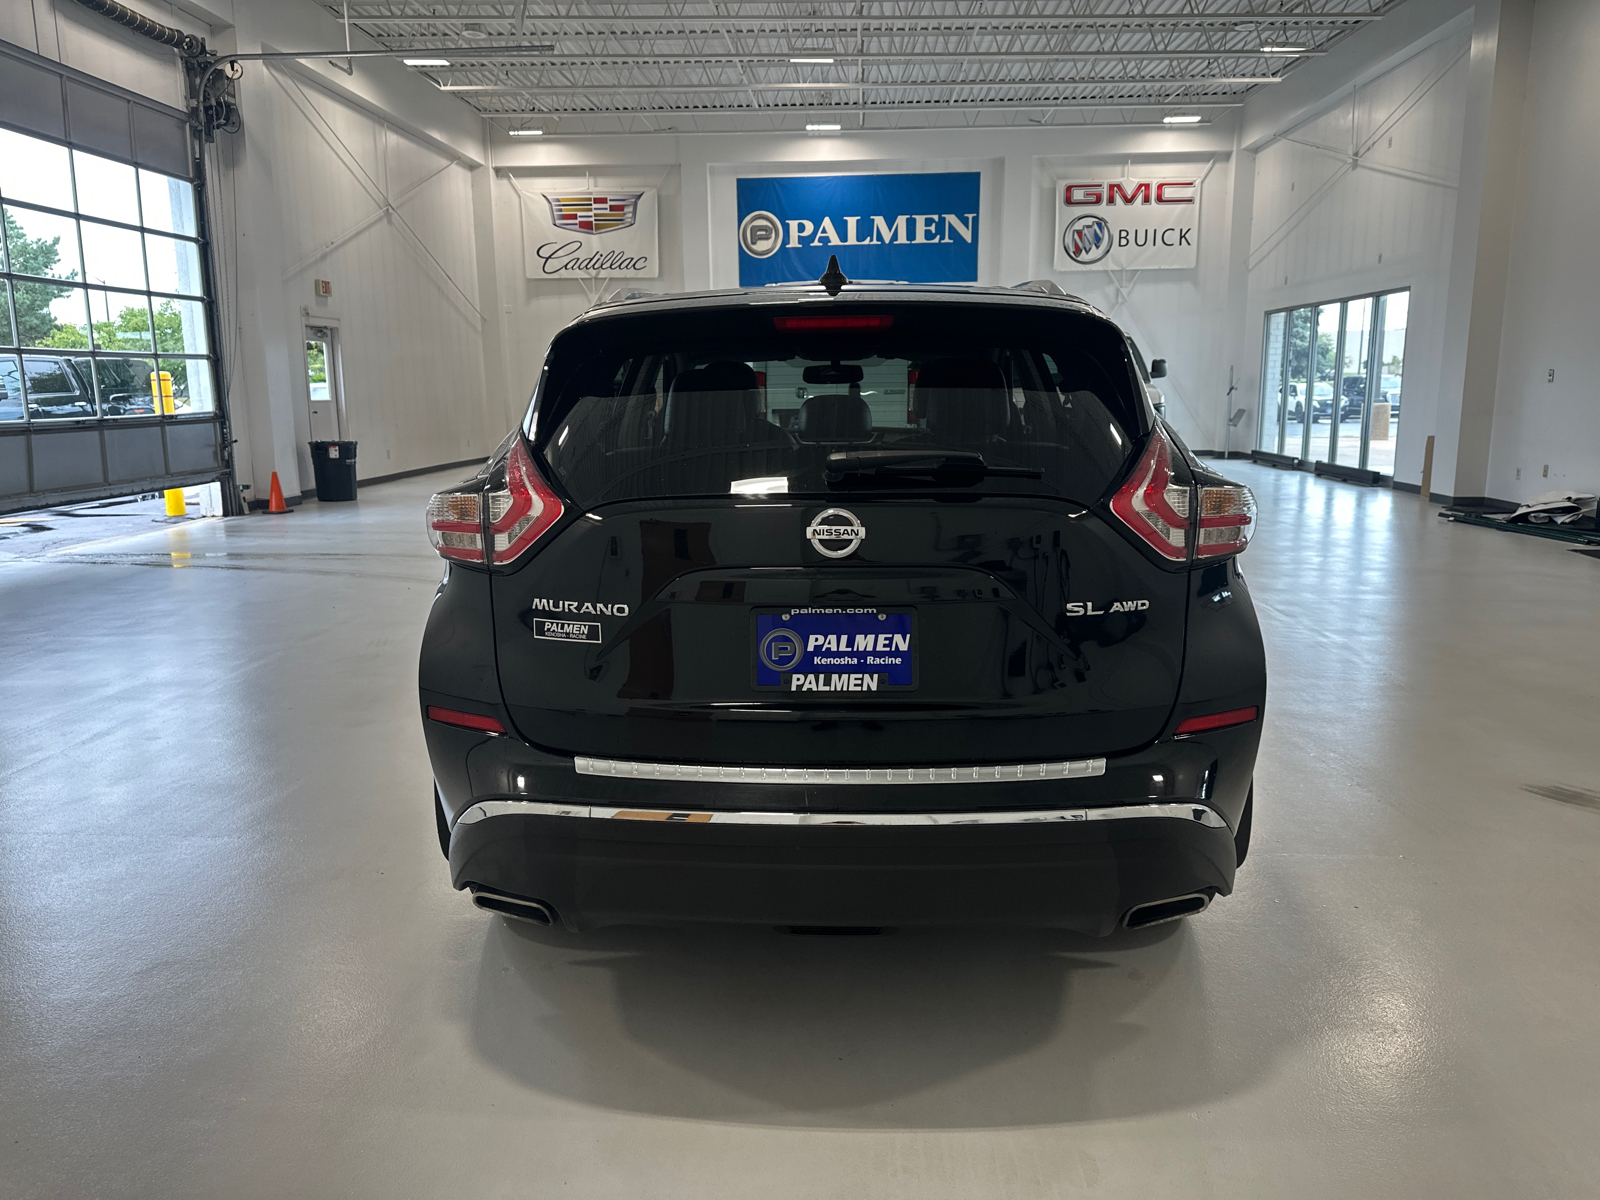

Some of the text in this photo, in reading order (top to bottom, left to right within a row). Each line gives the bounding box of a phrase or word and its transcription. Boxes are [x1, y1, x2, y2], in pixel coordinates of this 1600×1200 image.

[1063, 180, 1196, 207] GMC
[785, 213, 977, 248] PALMEN
[1118, 228, 1192, 247] BUICK
[536, 240, 647, 274] Cadillac
[812, 528, 859, 537] NISSAN
[532, 597, 630, 617] MURANO
[791, 607, 877, 616] palmen.com
[1065, 599, 1150, 616] SL AWD
[544, 621, 589, 635] PALMEN
[807, 633, 911, 652] PALMEN
[813, 656, 858, 665] Kenosha
[866, 656, 902, 665] Racine
[791, 673, 878, 691] PALMEN
